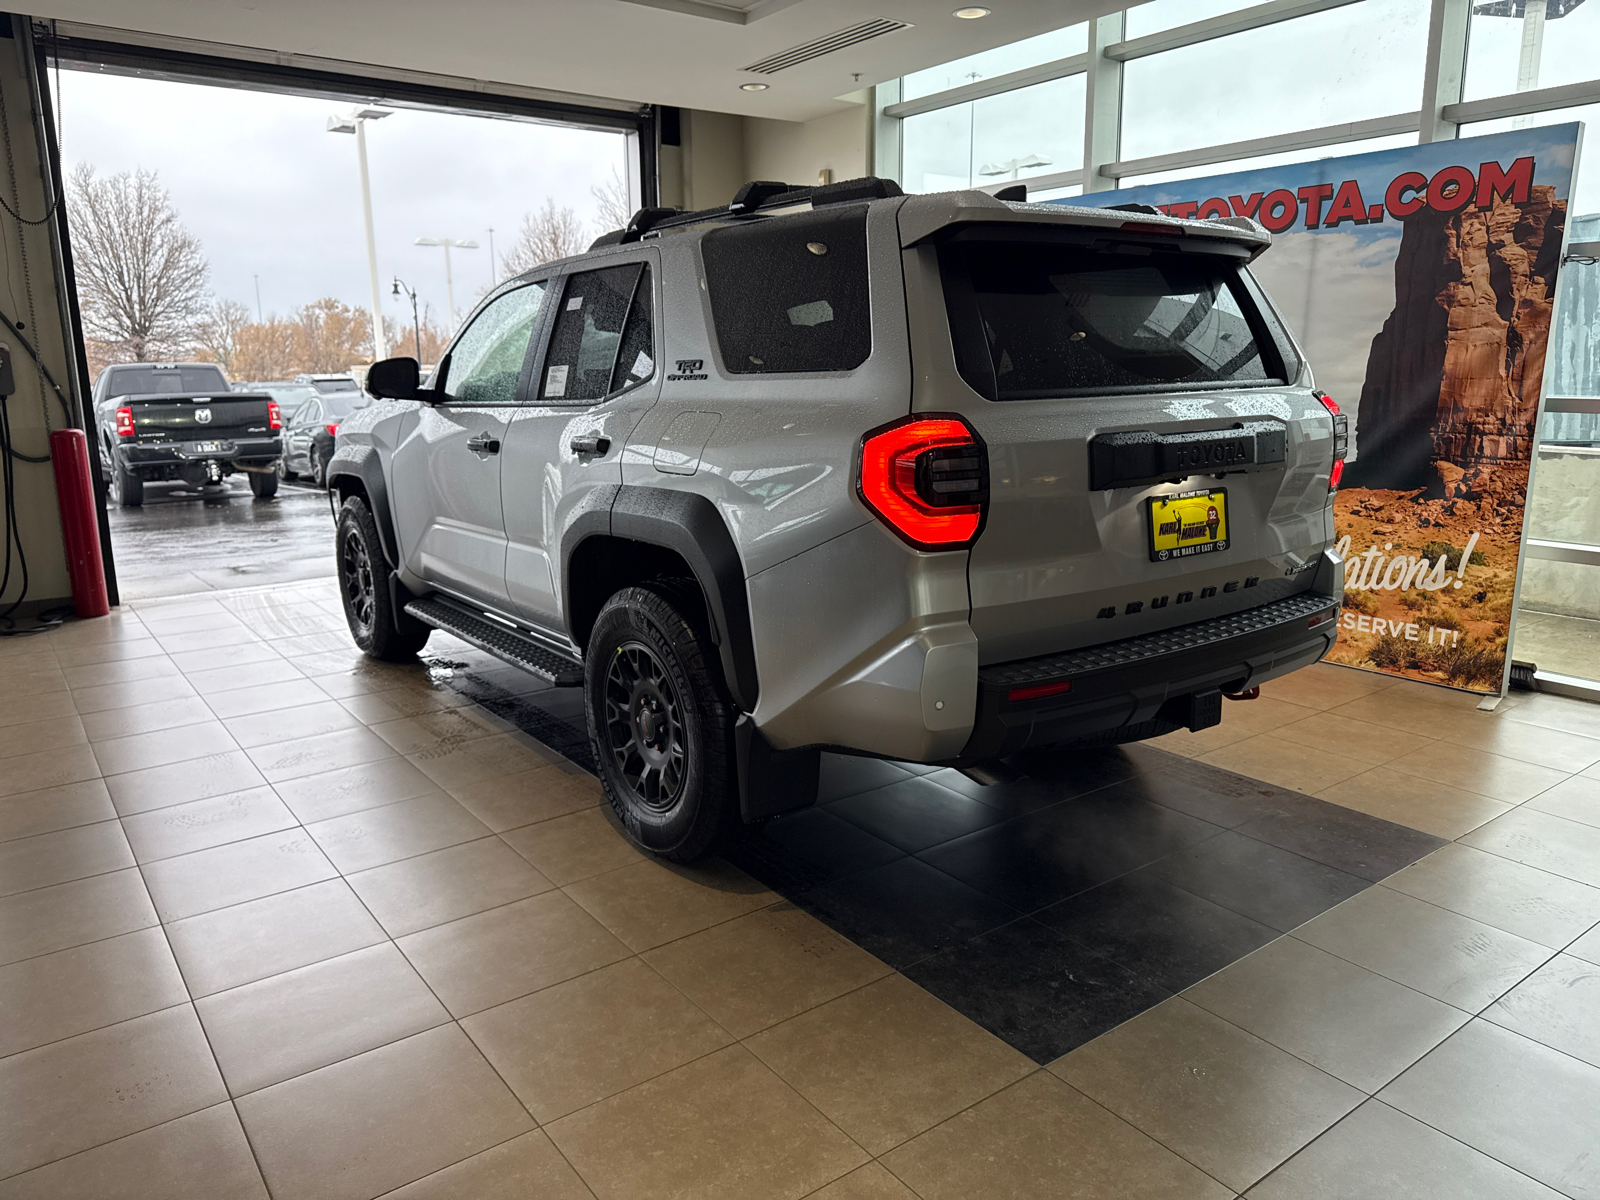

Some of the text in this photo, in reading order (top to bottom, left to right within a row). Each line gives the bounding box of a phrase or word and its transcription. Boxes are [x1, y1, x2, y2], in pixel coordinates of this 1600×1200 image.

[675, 359, 704, 374] TRD
[1177, 441, 1246, 467] TOYOTA
[1208, 510, 1216, 519] 32
[1159, 522, 1178, 536] KARL
[1181, 525, 1208, 540] MALONE
[1172, 543, 1213, 557] WE MAKE IT EASY
[1096, 576, 1260, 619] 4RUNNER
[1428, 625, 1459, 648] IT!
